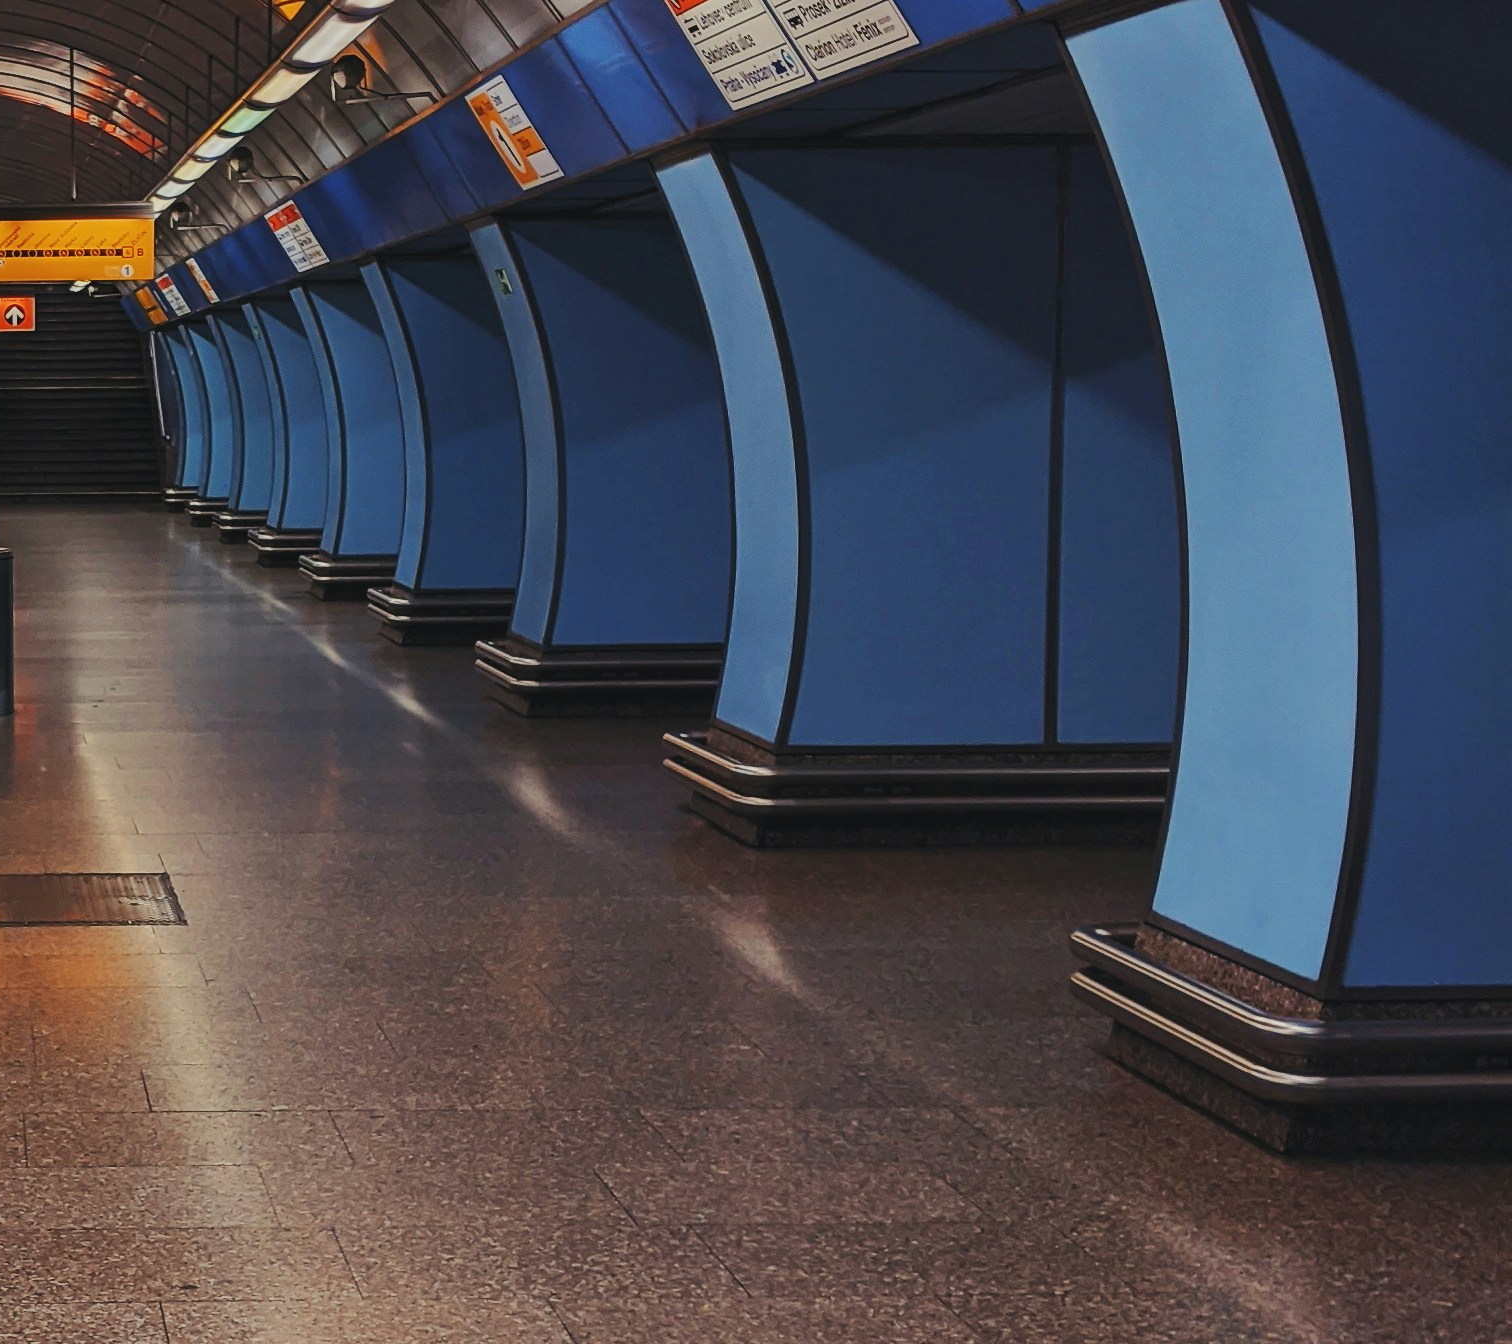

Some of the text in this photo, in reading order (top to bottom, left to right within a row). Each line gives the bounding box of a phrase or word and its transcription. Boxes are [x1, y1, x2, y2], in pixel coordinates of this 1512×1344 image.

[804, 18, 884, 63] Clarion Hotel Fénix
